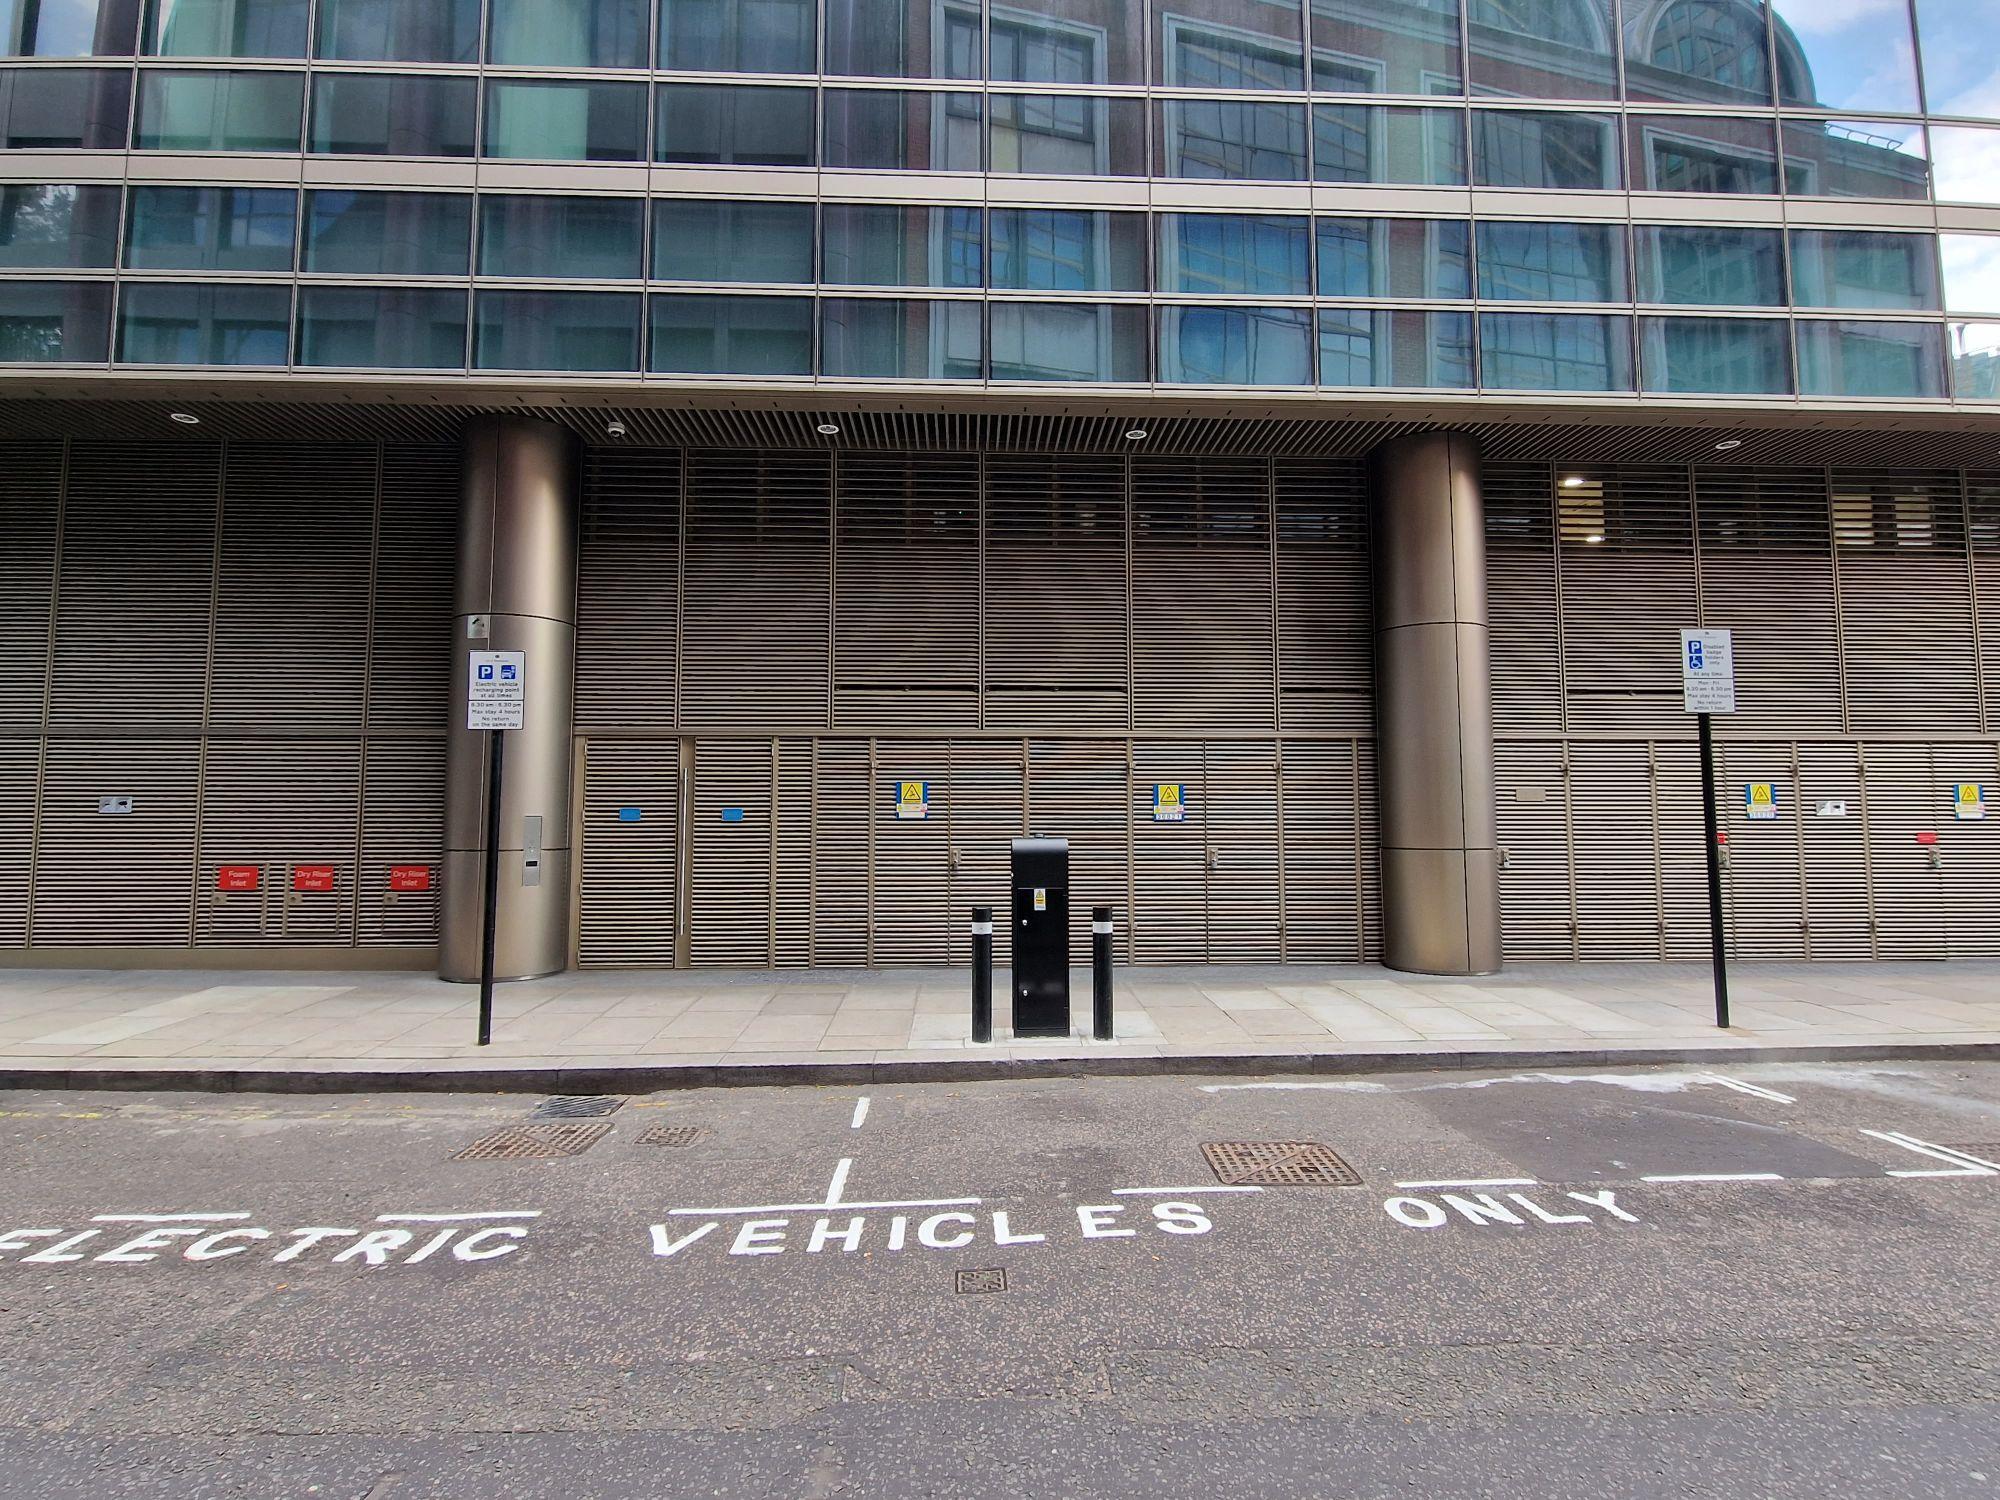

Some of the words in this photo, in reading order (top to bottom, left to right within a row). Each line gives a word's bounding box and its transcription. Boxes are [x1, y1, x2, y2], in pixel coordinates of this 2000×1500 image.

[1691, 642, 1700, 653] P
[482, 666, 492, 678] P
[297, 870, 312, 879] Dry
[393, 870, 406, 879] Dry
[0, 1228, 527, 1263] ELECTRIC
[649, 1202, 1212, 1257] VEHICLES
[1383, 1190, 1640, 1229] ONLY
